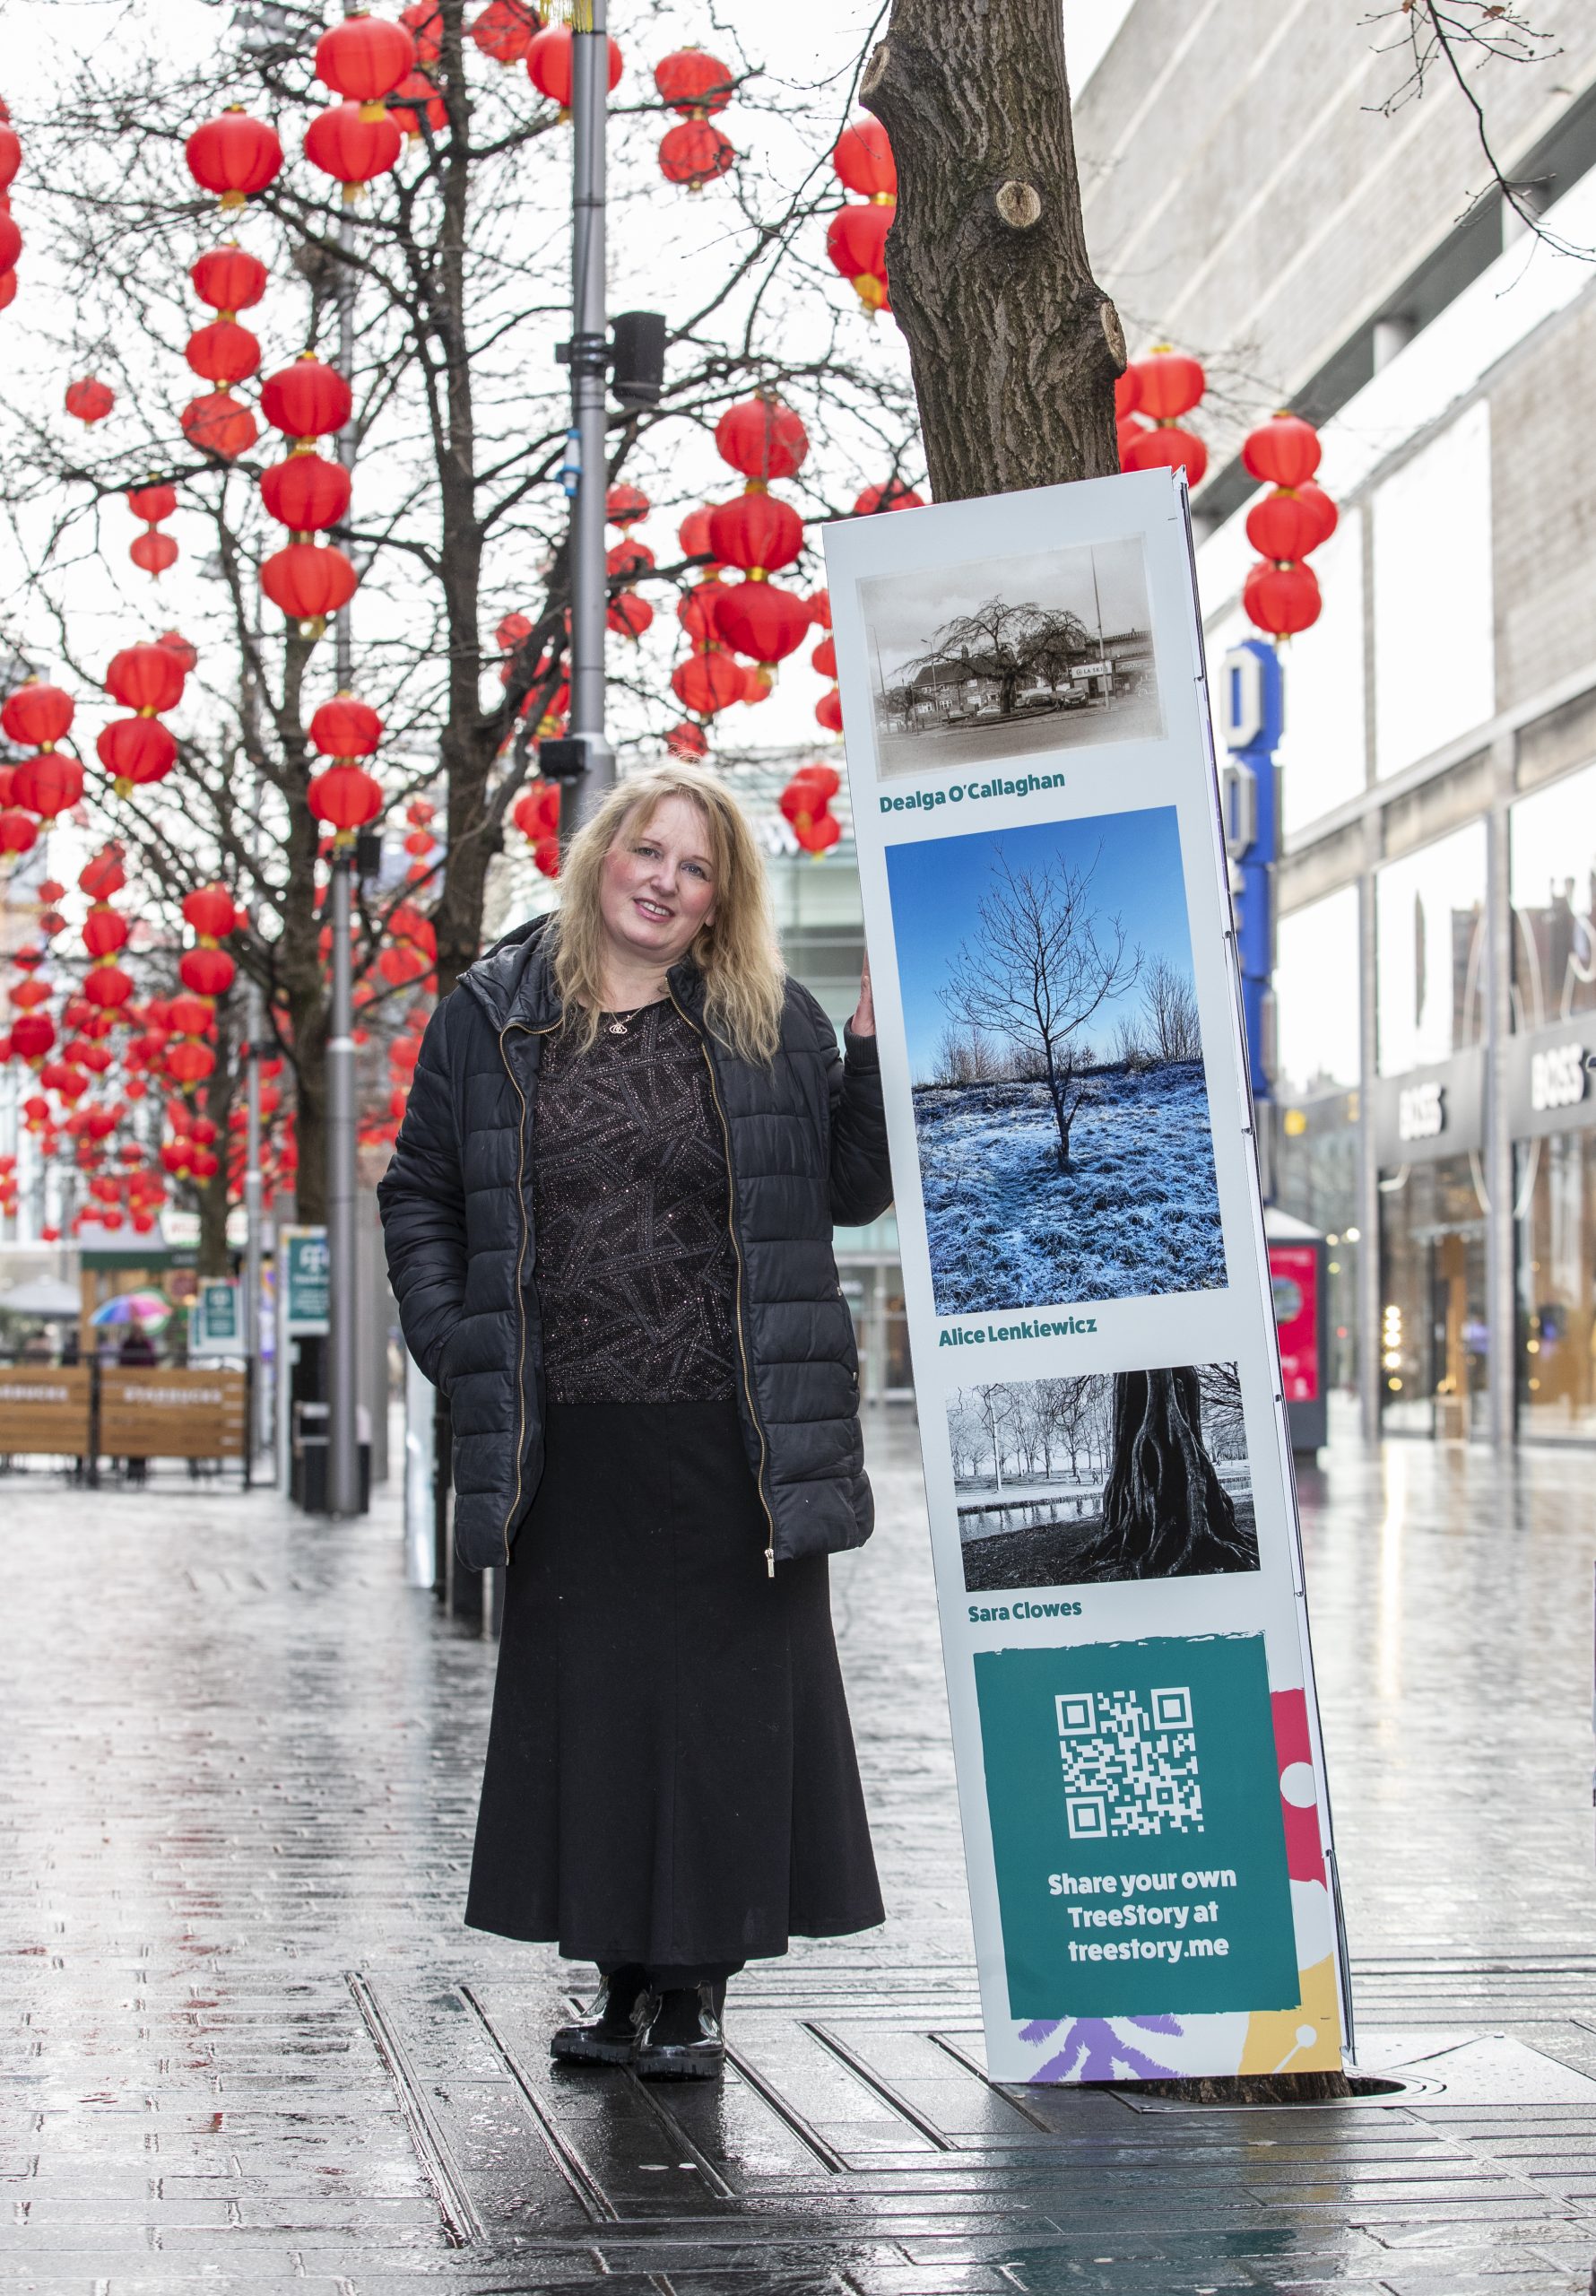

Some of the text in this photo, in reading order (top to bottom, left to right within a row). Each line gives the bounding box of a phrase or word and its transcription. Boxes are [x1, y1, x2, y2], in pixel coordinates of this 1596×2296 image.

[880, 773, 1065, 813] Dealga O'Callaghan
[939, 1316, 1097, 1346] Alice Lenkiewicz
[968, 1601, 1082, 1622] Sara Clowes
[1048, 1869, 1237, 1898] Share your own
[1067, 1901, 1219, 1929] TreeStory at
[1068, 1937, 1229, 1963] treestory.me
